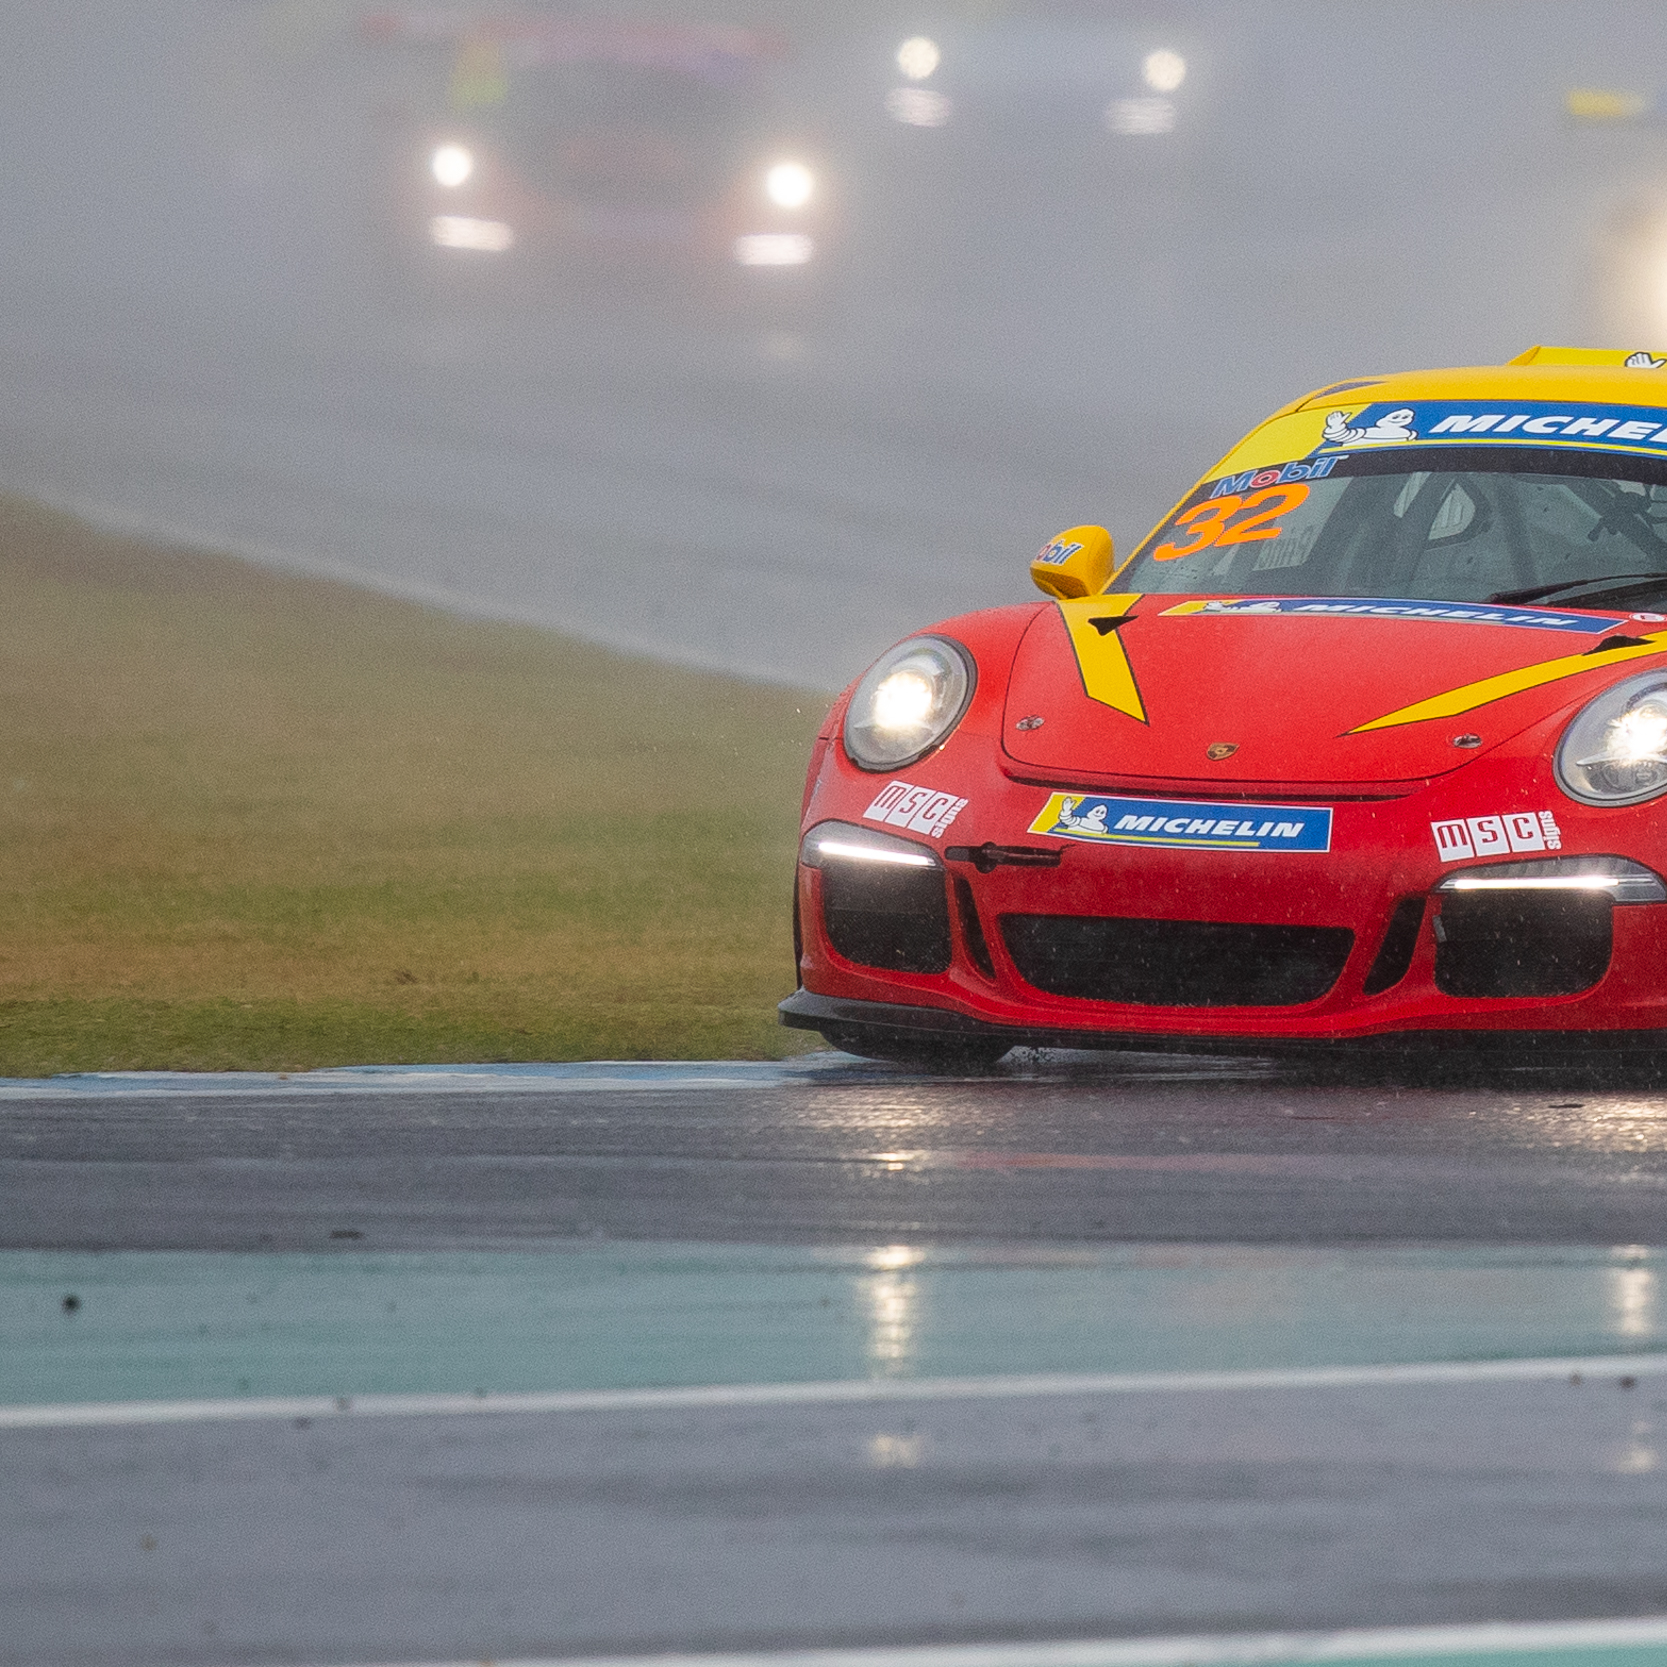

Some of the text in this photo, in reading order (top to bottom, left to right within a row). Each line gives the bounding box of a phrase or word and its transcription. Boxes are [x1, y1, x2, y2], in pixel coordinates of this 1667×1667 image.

[1209, 454, 1348, 499] Mobil
[1153, 483, 1310, 561] 32
[1036, 539, 1084, 565] obil
[1299, 604, 1579, 626] MICHELIN
[1114, 814, 1304, 838] MICHELIN
[1538, 810, 1562, 851] signs
